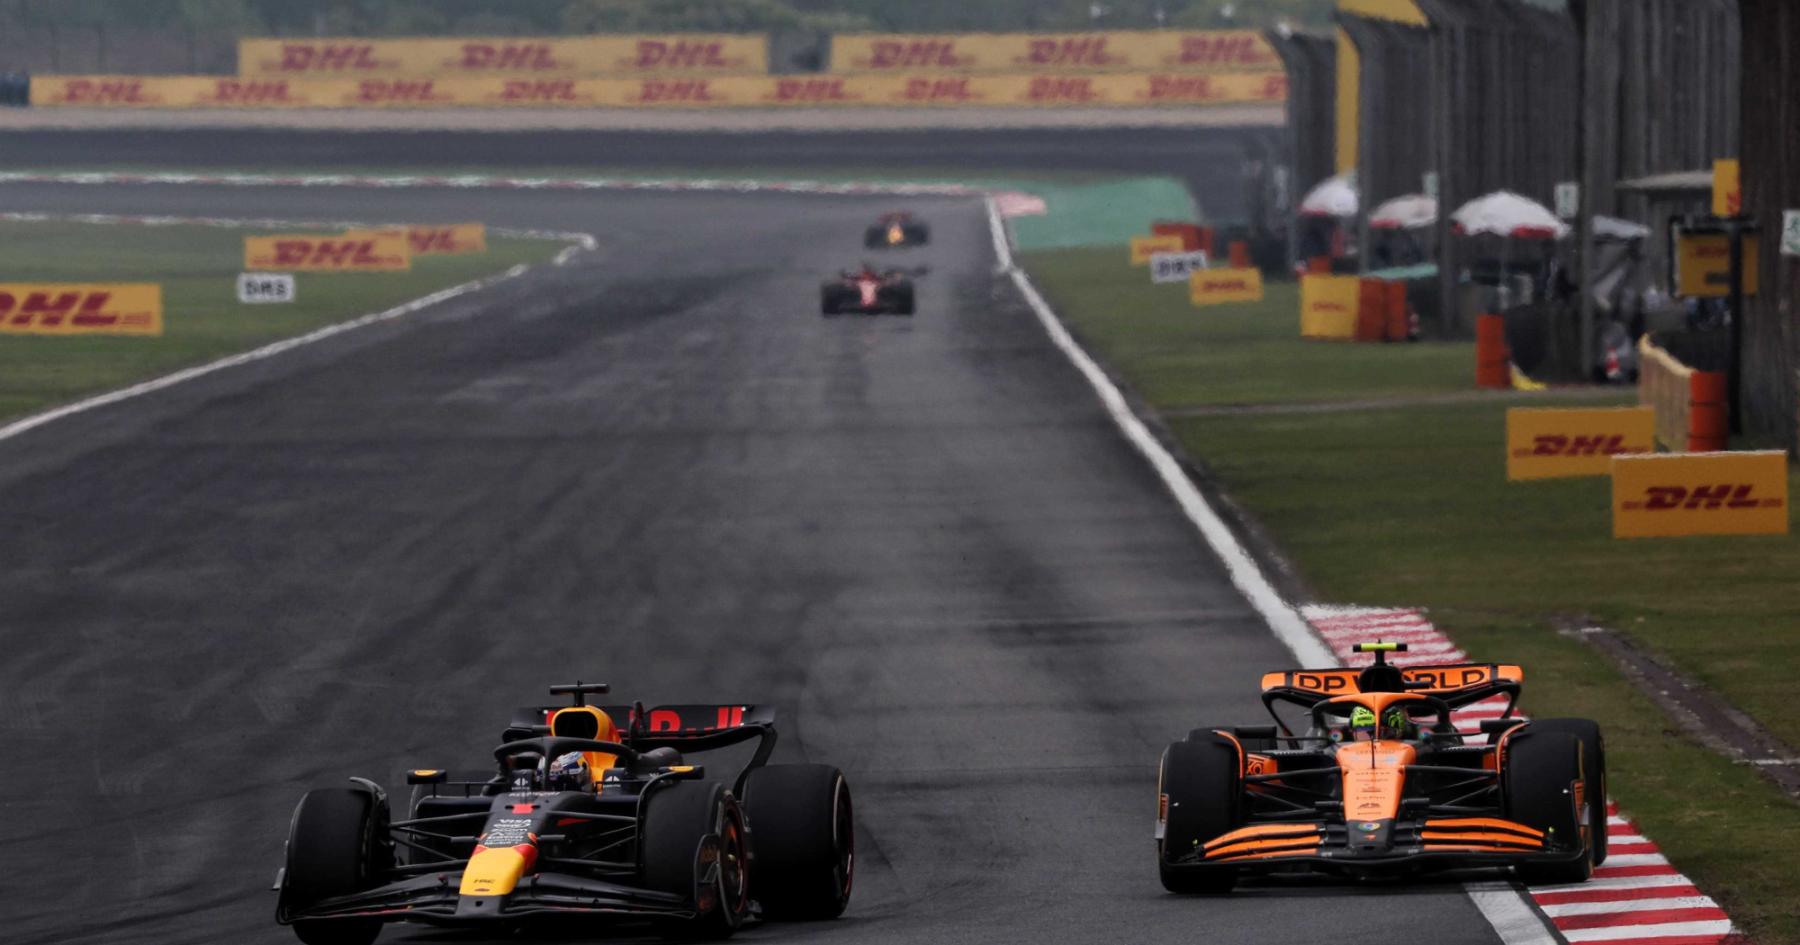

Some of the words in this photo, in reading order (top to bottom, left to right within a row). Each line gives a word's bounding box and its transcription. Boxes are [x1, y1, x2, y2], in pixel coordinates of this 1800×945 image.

[282, 45, 377, 69] DHL
[461, 44, 557, 69] DHL
[635, 41, 727, 67] DHL
[869, 41, 961, 67] DHL
[1028, 39, 1111, 65] DHL
[1180, 37, 1256, 63] DHL
[65, 80, 144, 101] DHL
[214, 81, 288, 101] DHL
[358, 81, 434, 101] DHL
[502, 81, 576, 100] DHL
[641, 80, 713, 100] DHL
[776, 80, 845, 99] DHL
[905, 80, 971, 100] DHL
[1029, 77, 1095, 99] DHL
[1149, 75, 1210, 98] DHL
[273, 240, 379, 266] DHL
[1533, 434, 1627, 456] DHL
[1645, 484, 1759, 510] DHL
[1299, 674, 1346, 691] DP
